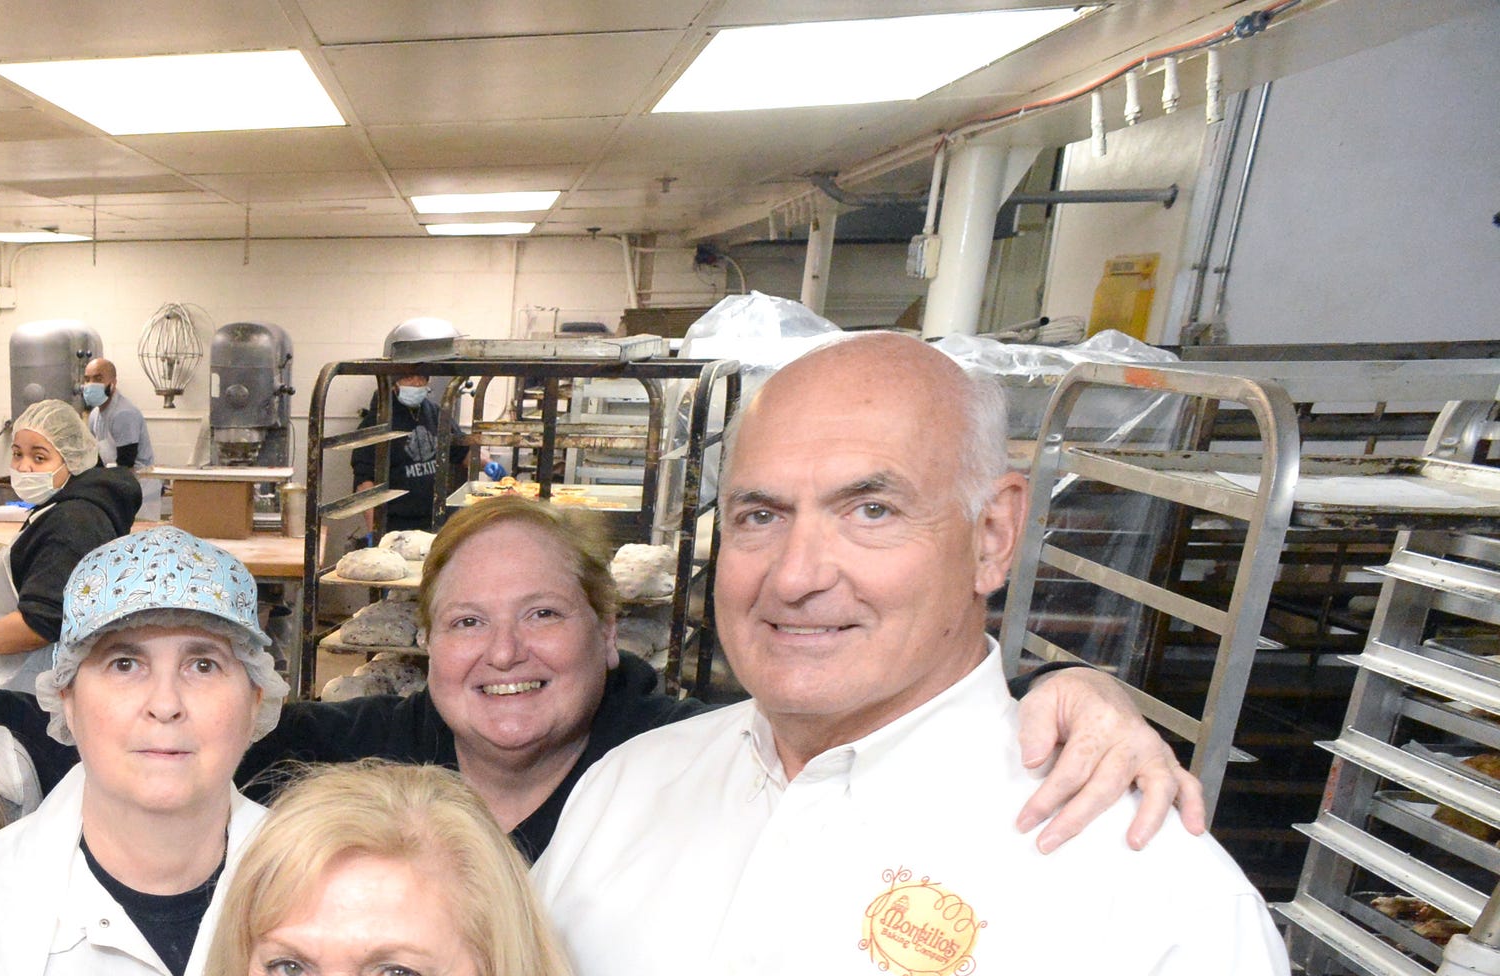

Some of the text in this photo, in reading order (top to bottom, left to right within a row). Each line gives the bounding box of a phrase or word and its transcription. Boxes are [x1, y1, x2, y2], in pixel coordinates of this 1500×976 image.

[404, 460, 437, 478] MEXIC
[880, 907, 960, 959] Montilio's
[881, 928, 950, 965] Baking Company
